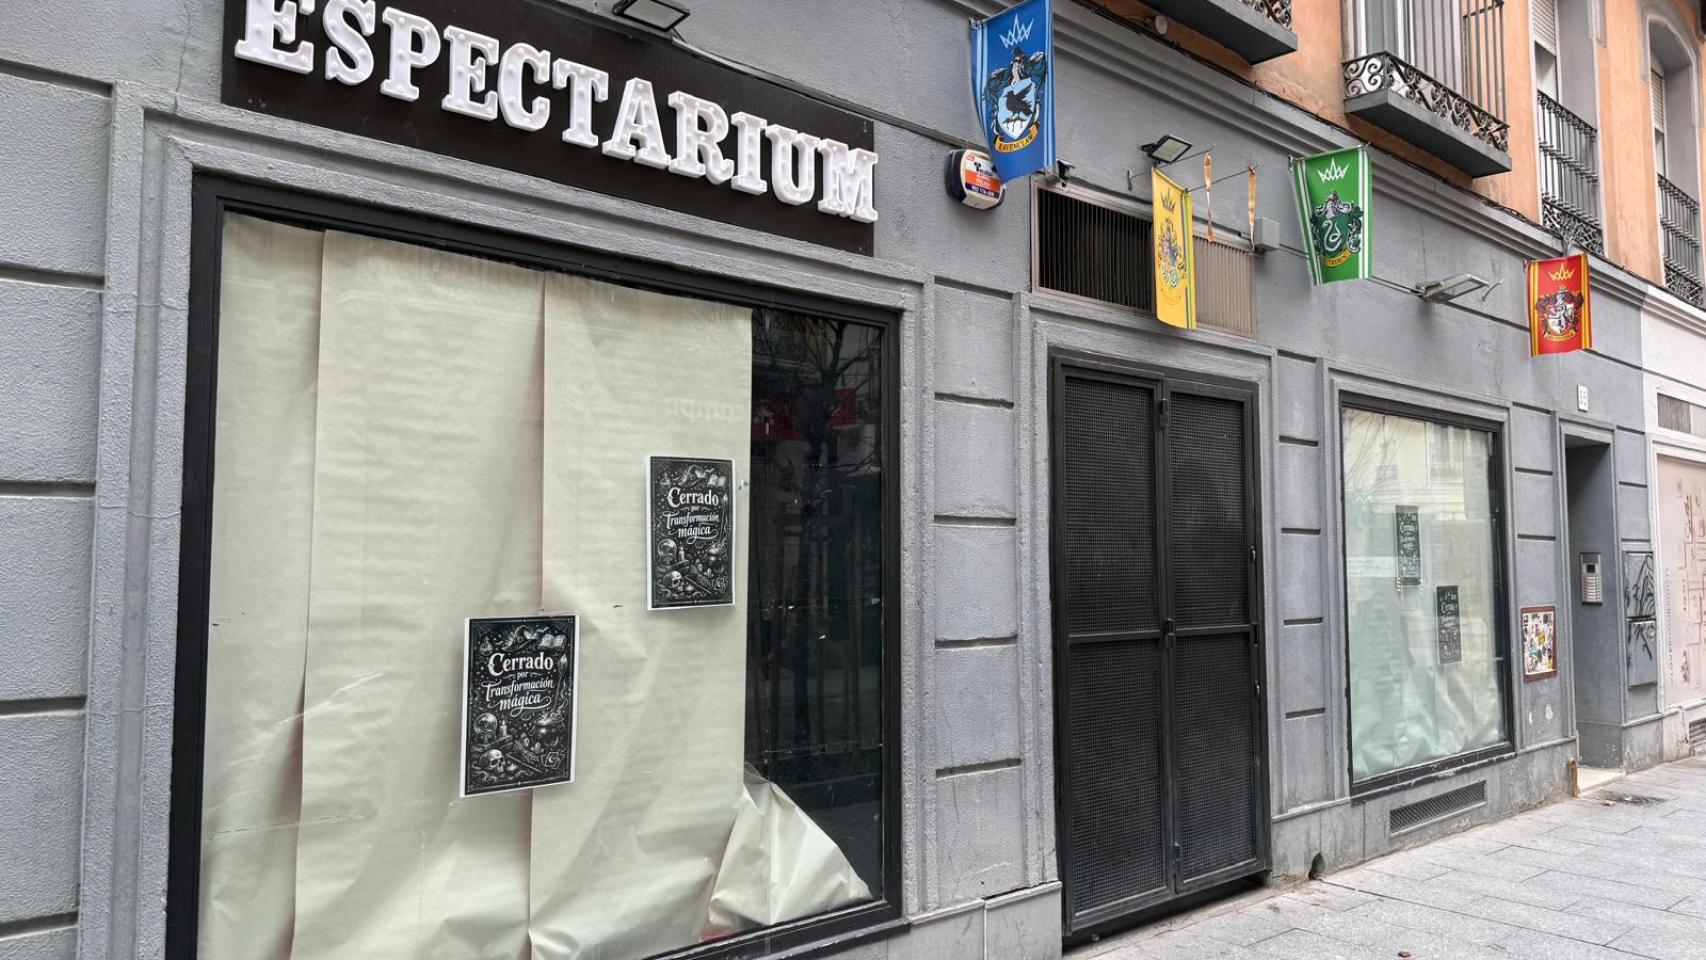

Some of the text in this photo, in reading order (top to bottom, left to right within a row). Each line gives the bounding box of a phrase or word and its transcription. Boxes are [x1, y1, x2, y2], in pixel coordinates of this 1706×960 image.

[235, 0, 878, 223] ESPECTARIUM
[667, 486, 719, 507] Cerrado
[662, 510, 720, 529] Transformación
[670, 524, 718, 544] mágica
[487, 652, 554, 676] Cerrado
[516, 672, 529, 680] por
[481, 677, 555, 702] Transformación
[489, 692, 551, 717] mágica
